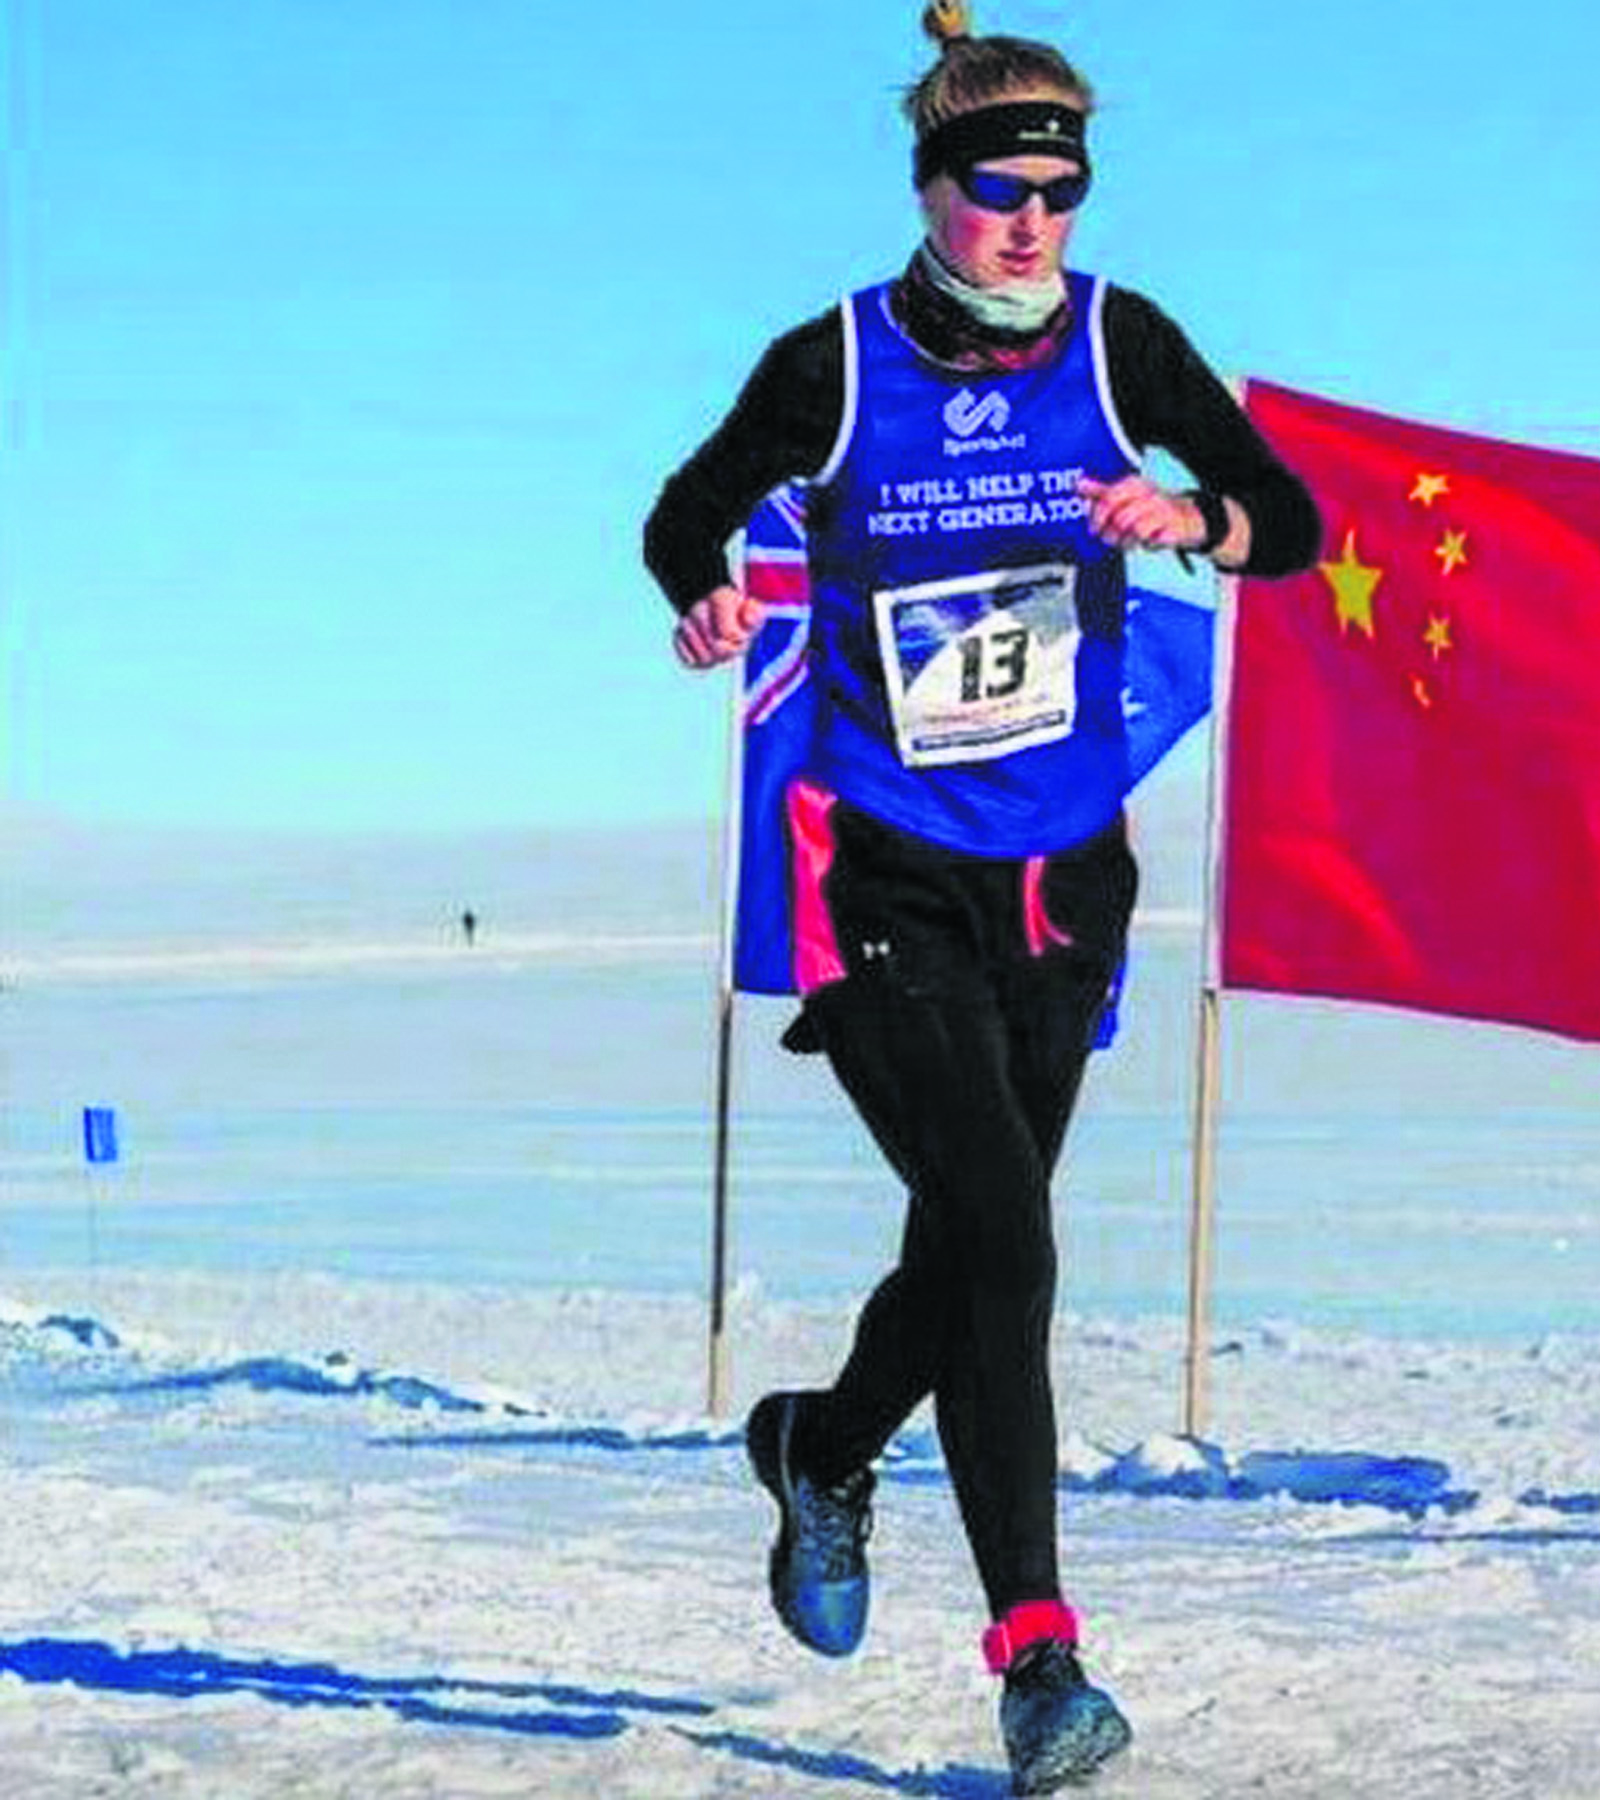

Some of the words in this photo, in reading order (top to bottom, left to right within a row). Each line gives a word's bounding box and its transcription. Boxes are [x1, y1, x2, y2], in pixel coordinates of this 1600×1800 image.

[896, 479, 963, 505] WILL
[967, 473, 1034, 501] HELP
[868, 510, 930, 536] NEXT
[957, 627, 1029, 703] 13
